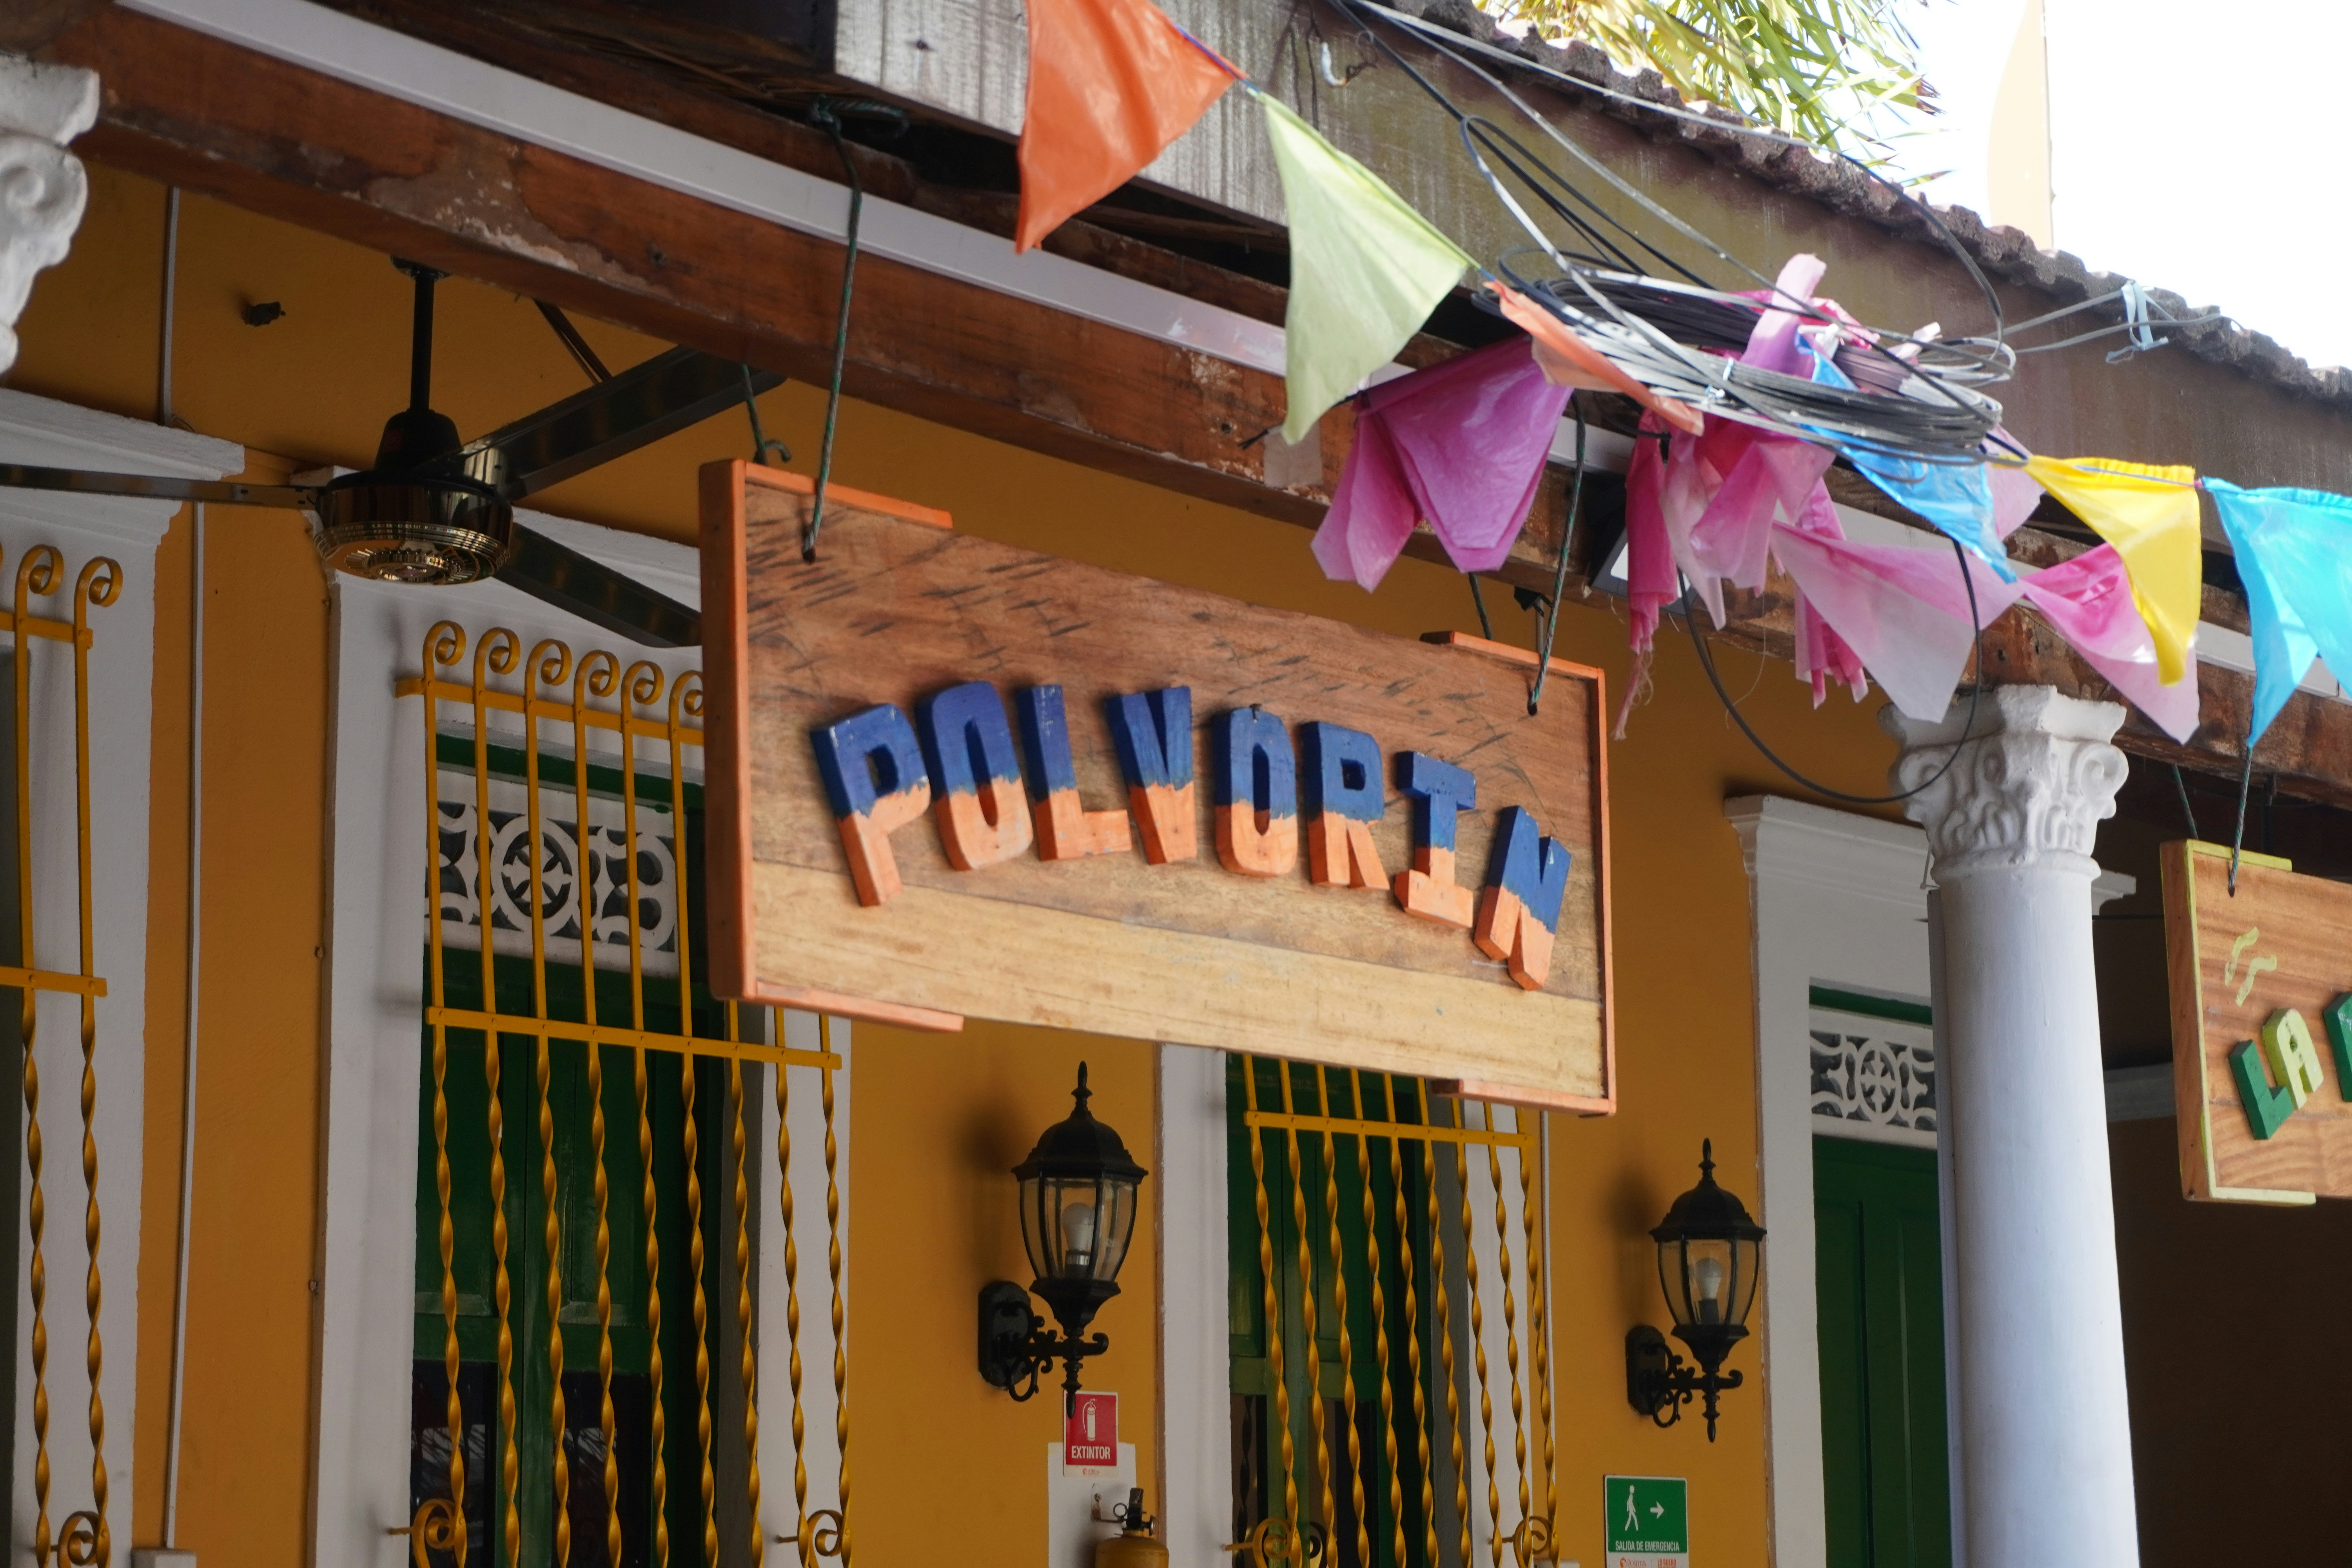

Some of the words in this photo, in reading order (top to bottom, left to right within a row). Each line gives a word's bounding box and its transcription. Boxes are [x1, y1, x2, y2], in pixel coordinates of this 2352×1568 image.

[810, 680, 1573, 992] POLVORIN
[1072, 1445, 1111, 1459] EXTINTOR
[1615, 1541, 1635, 1551] SALIDA
[1636, 1541, 1644, 1551] DE
[1645, 1541, 1679, 1552] EMERGENCIA
